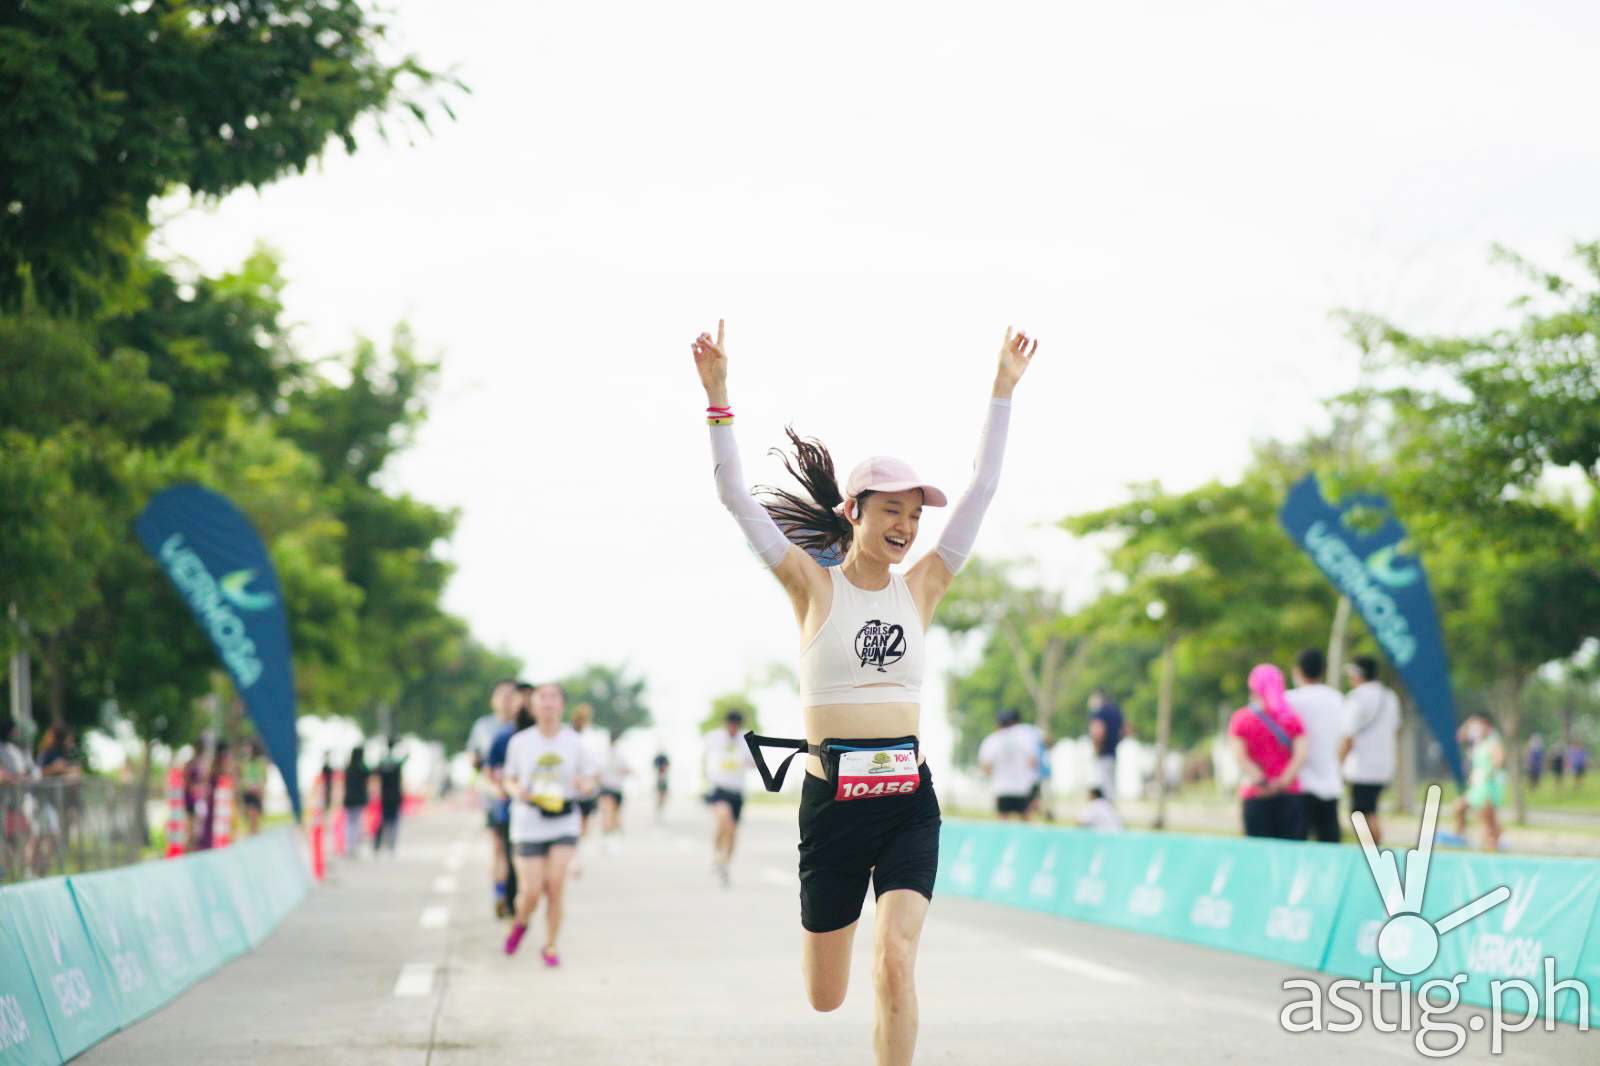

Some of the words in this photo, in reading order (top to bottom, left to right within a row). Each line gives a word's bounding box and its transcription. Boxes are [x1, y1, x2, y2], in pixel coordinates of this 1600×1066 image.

[1304, 520, 1417, 667] VERMOSA
[160, 532, 263, 688] VERMOSA
[864, 626, 888, 636] GIRLS
[864, 635, 889, 648] CAN
[886, 624, 904, 656] 2
[862, 647, 886, 661] RUN
[842, 781, 915, 798] 10456
